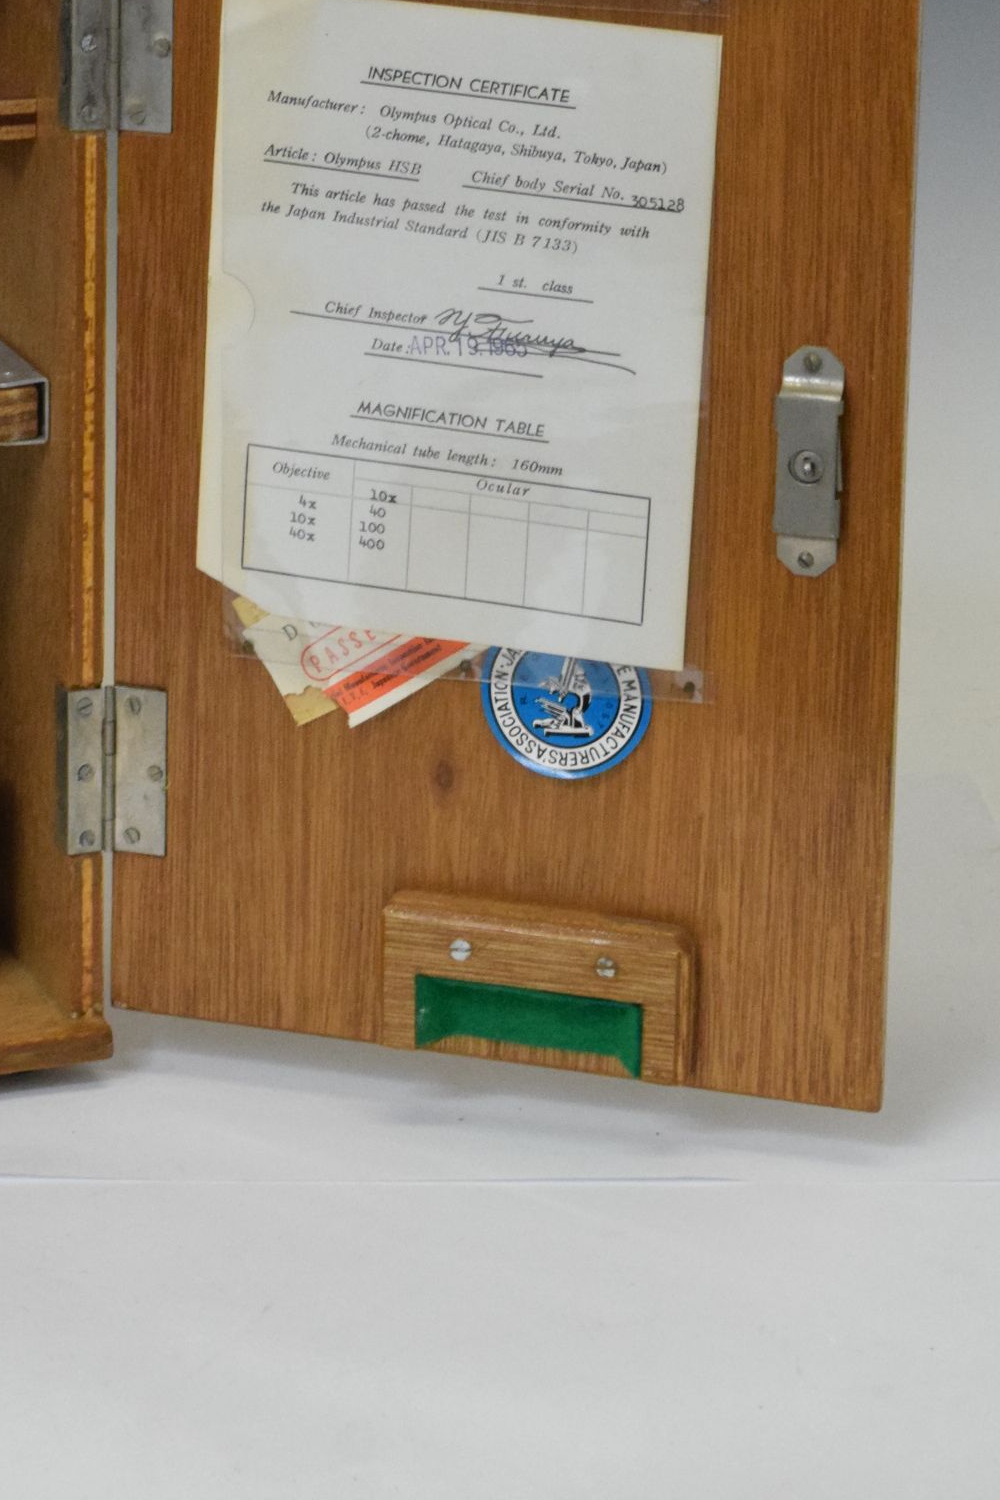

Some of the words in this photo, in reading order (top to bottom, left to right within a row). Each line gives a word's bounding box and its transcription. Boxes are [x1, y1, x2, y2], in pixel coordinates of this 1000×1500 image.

[367, 66, 463, 91] INSPECTION
[469, 78, 570, 103] CERTIFICATE
[380, 105, 436, 124] Olympus
[443, 113, 492, 130] Optical
[498, 119, 524, 136] Co.,
[532, 123, 561, 139] Ltd.
[365, 125, 430, 146] (2-chome,
[438, 135, 505, 156] Hatagaya,
[510, 143, 566, 163] Shibuya,
[574, 150, 617, 169] Tokyo,
[620, 156, 667, 174] Japan)
[324, 151, 381, 171] Olympus
[388, 159, 422, 176] HSB
[471, 170, 510, 187] Chief
[515, 175, 546, 191] body
[552, 180, 595, 197] Serial
[601, 186, 624, 201] No.
[631, 194, 685, 213] 305128
[291, 182, 320, 198] This
[325, 188, 367, 204] article
[372, 193, 396, 208] has
[401, 198, 447, 214] passed
[454, 204, 475, 218] the
[483, 208, 507, 222] test
[516, 211, 530, 224] in
[538, 216, 612, 236] conformity
[620, 225, 650, 239] with
[261, 201, 281, 214] the
[285, 203, 326, 221] Japan
[332, 210, 400, 230] Industrial
[404, 218, 469, 239] Standard
[476, 228, 507, 244] (JIS
[513, 234, 525, 246] B
[542, 280, 573, 295] class
[324, 300, 363, 317] Chief
[368, 307, 428, 325] Inspector
[409, 335, 450, 356] APR.
[356, 400, 487, 429] MAGNIFICATION
[496, 418, 545, 437] TABLE
[331, 433, 408, 455] Mechanical
[412, 445, 440, 460] tube
[511, 458, 563, 476] 160mm
[272, 461, 331, 480] Objective
[476, 478, 531, 496] Ocular
[290, 511, 316, 526] 10x
[369, 504, 386, 518] 40
[289, 526, 315, 542] 40x
[359, 521, 386, 534] 100
[358, 536, 385, 550] 400
